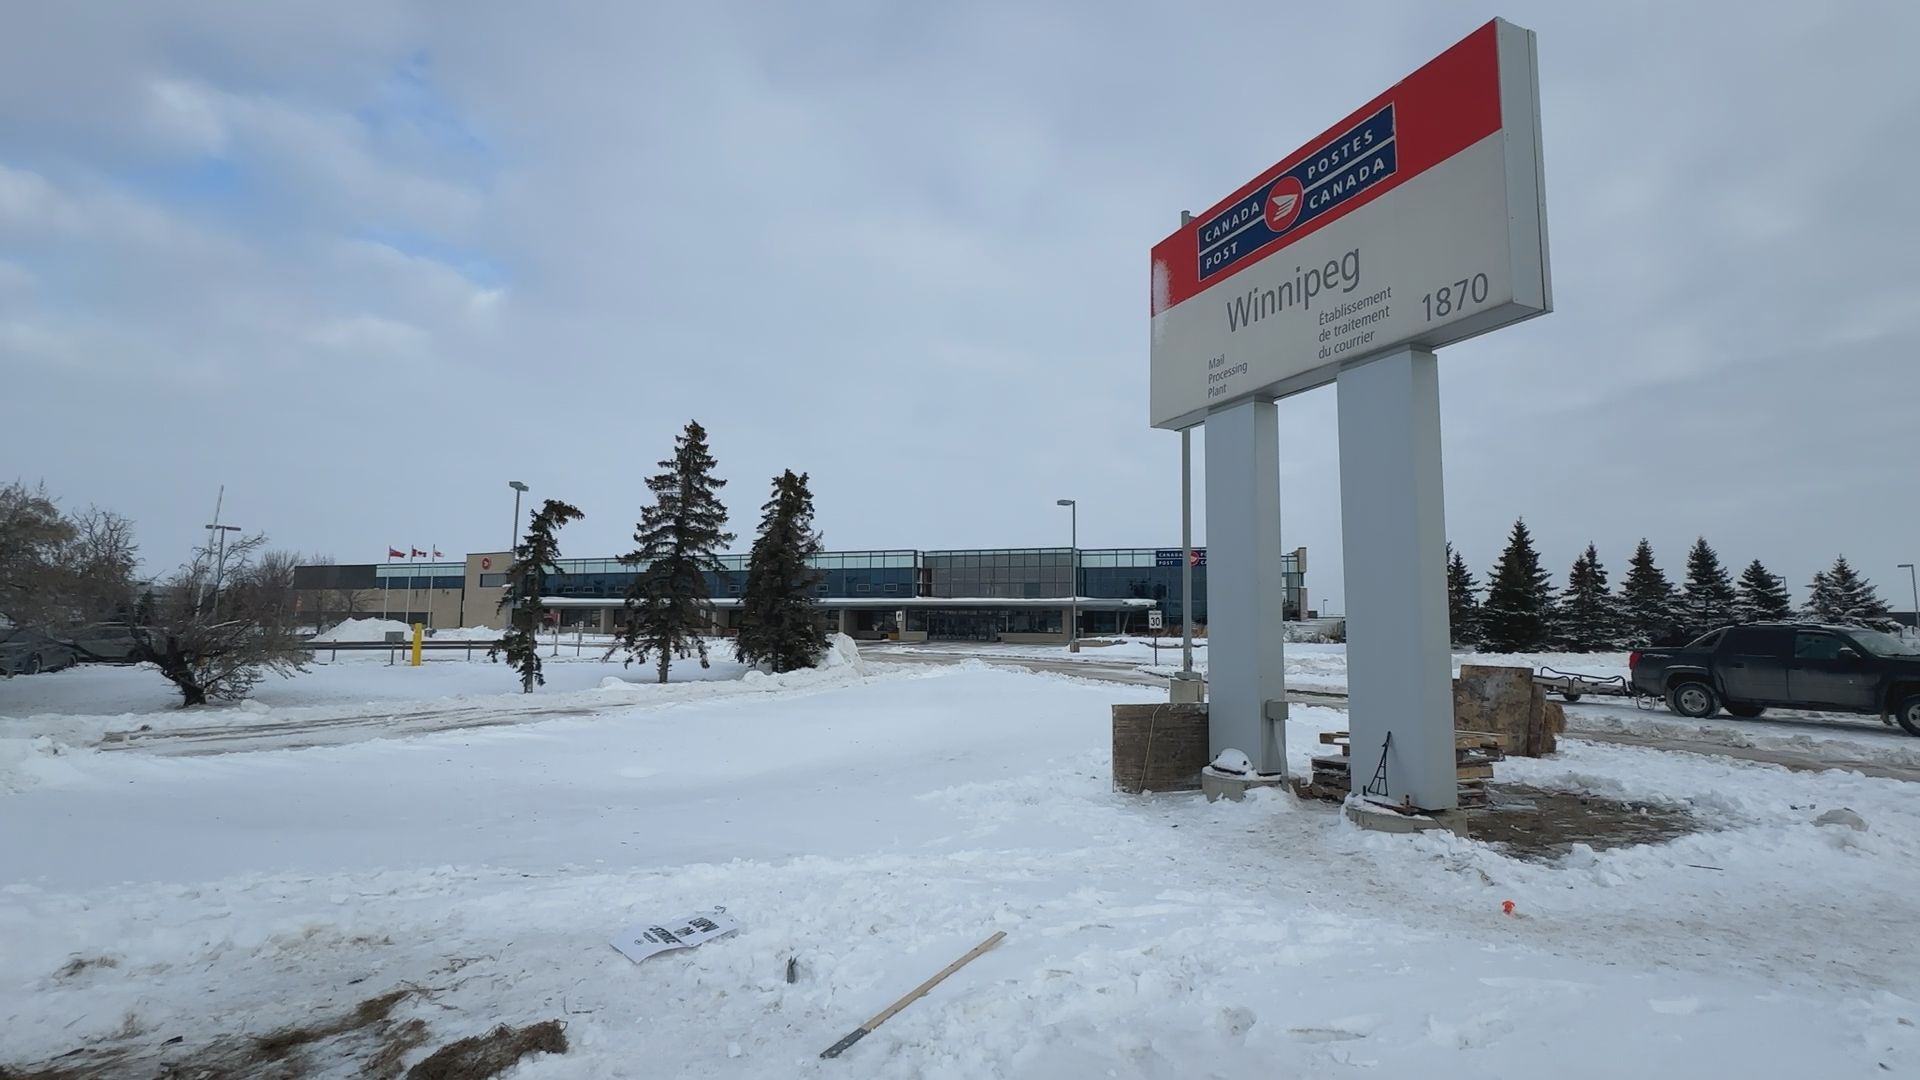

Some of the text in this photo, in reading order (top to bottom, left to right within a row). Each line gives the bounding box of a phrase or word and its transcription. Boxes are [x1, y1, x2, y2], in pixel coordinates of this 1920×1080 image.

[1308, 129, 1373, 179] POSTES
[1309, 157, 1385, 209] CANADA
[1204, 201, 1260, 242] CANADA
[1206, 242, 1238, 269] POST
[1227, 248, 1360, 333] Winnipeg
[1319, 286, 1392, 325] Établissement
[1422, 272, 1488, 322] 1870
[1319, 306, 1390, 343] de traitement
[1208, 354, 1225, 370] Mail
[1319, 330, 1375, 359] du courrier
[1207, 383, 1227, 399] Plant
[1208, 361, 1248, 384] Processing
[1150, 617, 1161, 626] 30
